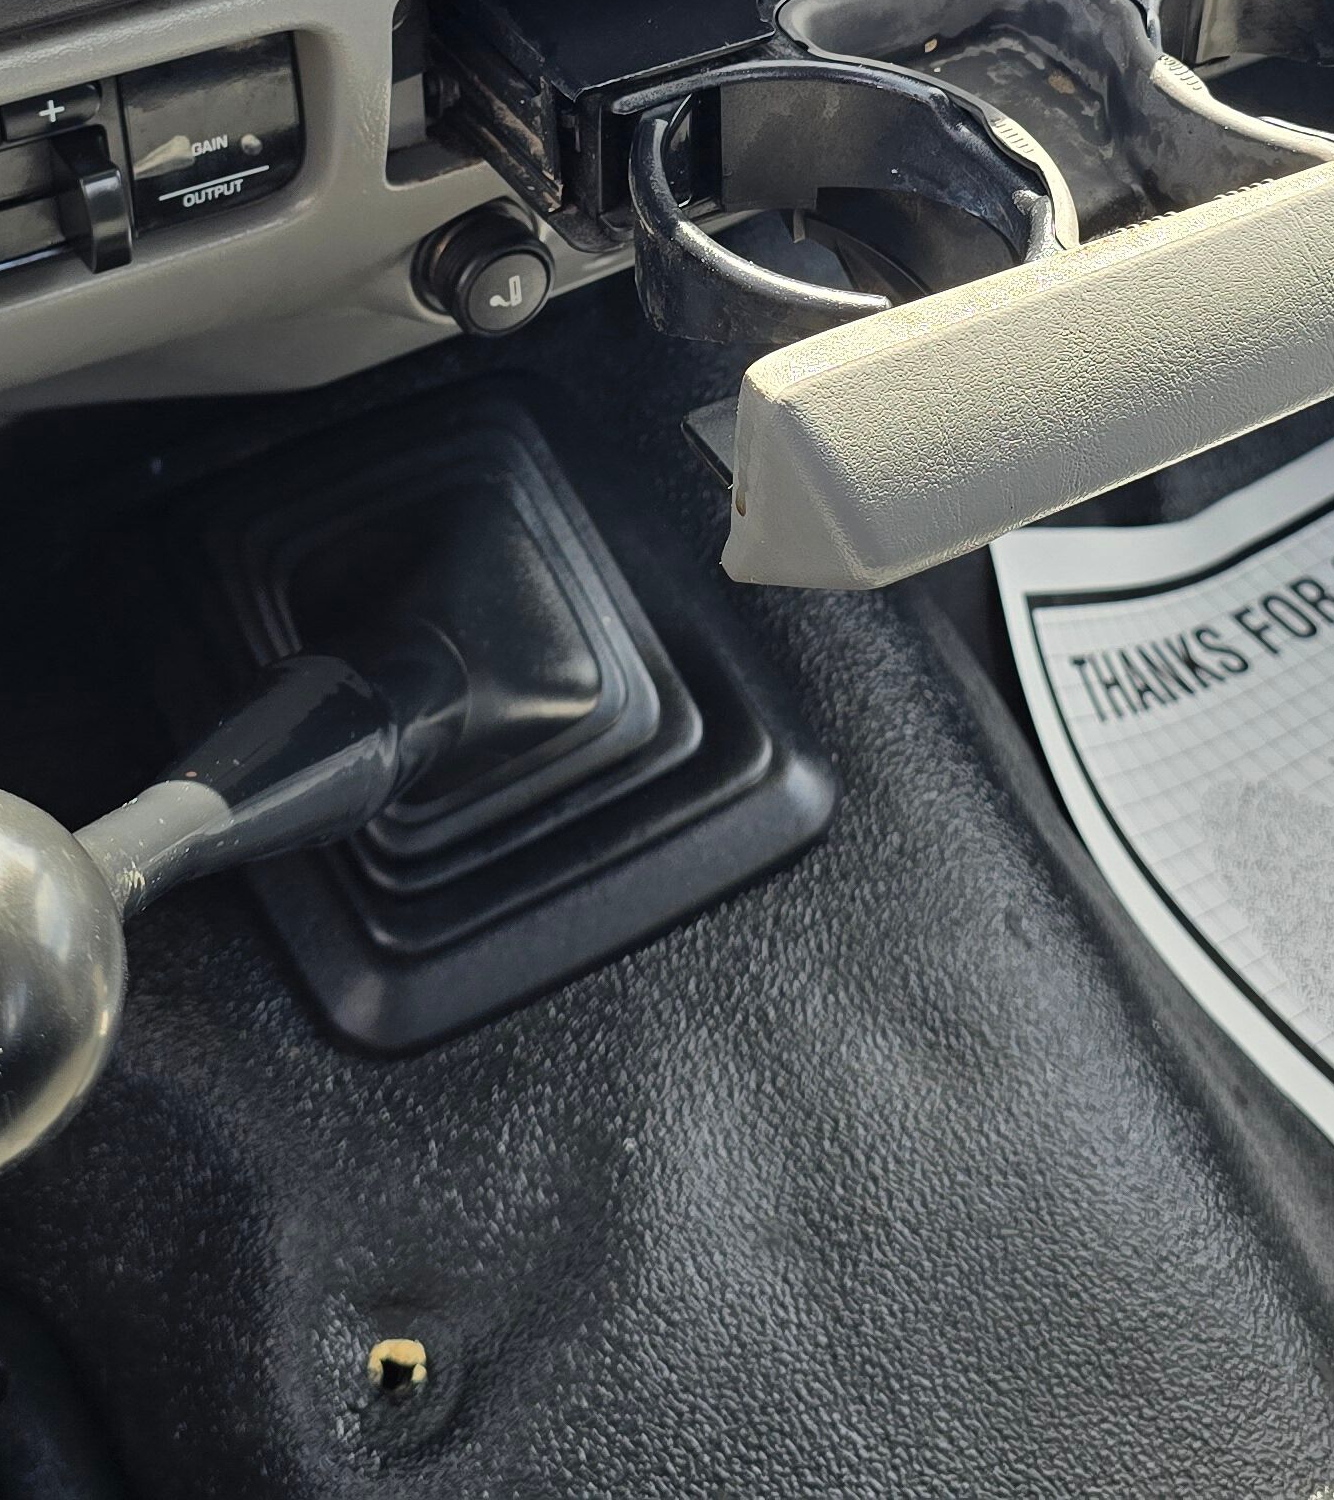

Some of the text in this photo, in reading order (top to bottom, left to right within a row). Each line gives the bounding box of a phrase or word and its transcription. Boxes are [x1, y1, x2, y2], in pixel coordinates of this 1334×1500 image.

[191, 134, 228, 158] GAIN
[182, 178, 244, 209] OUTPUT
[1070, 626, 1250, 725] THANKS
